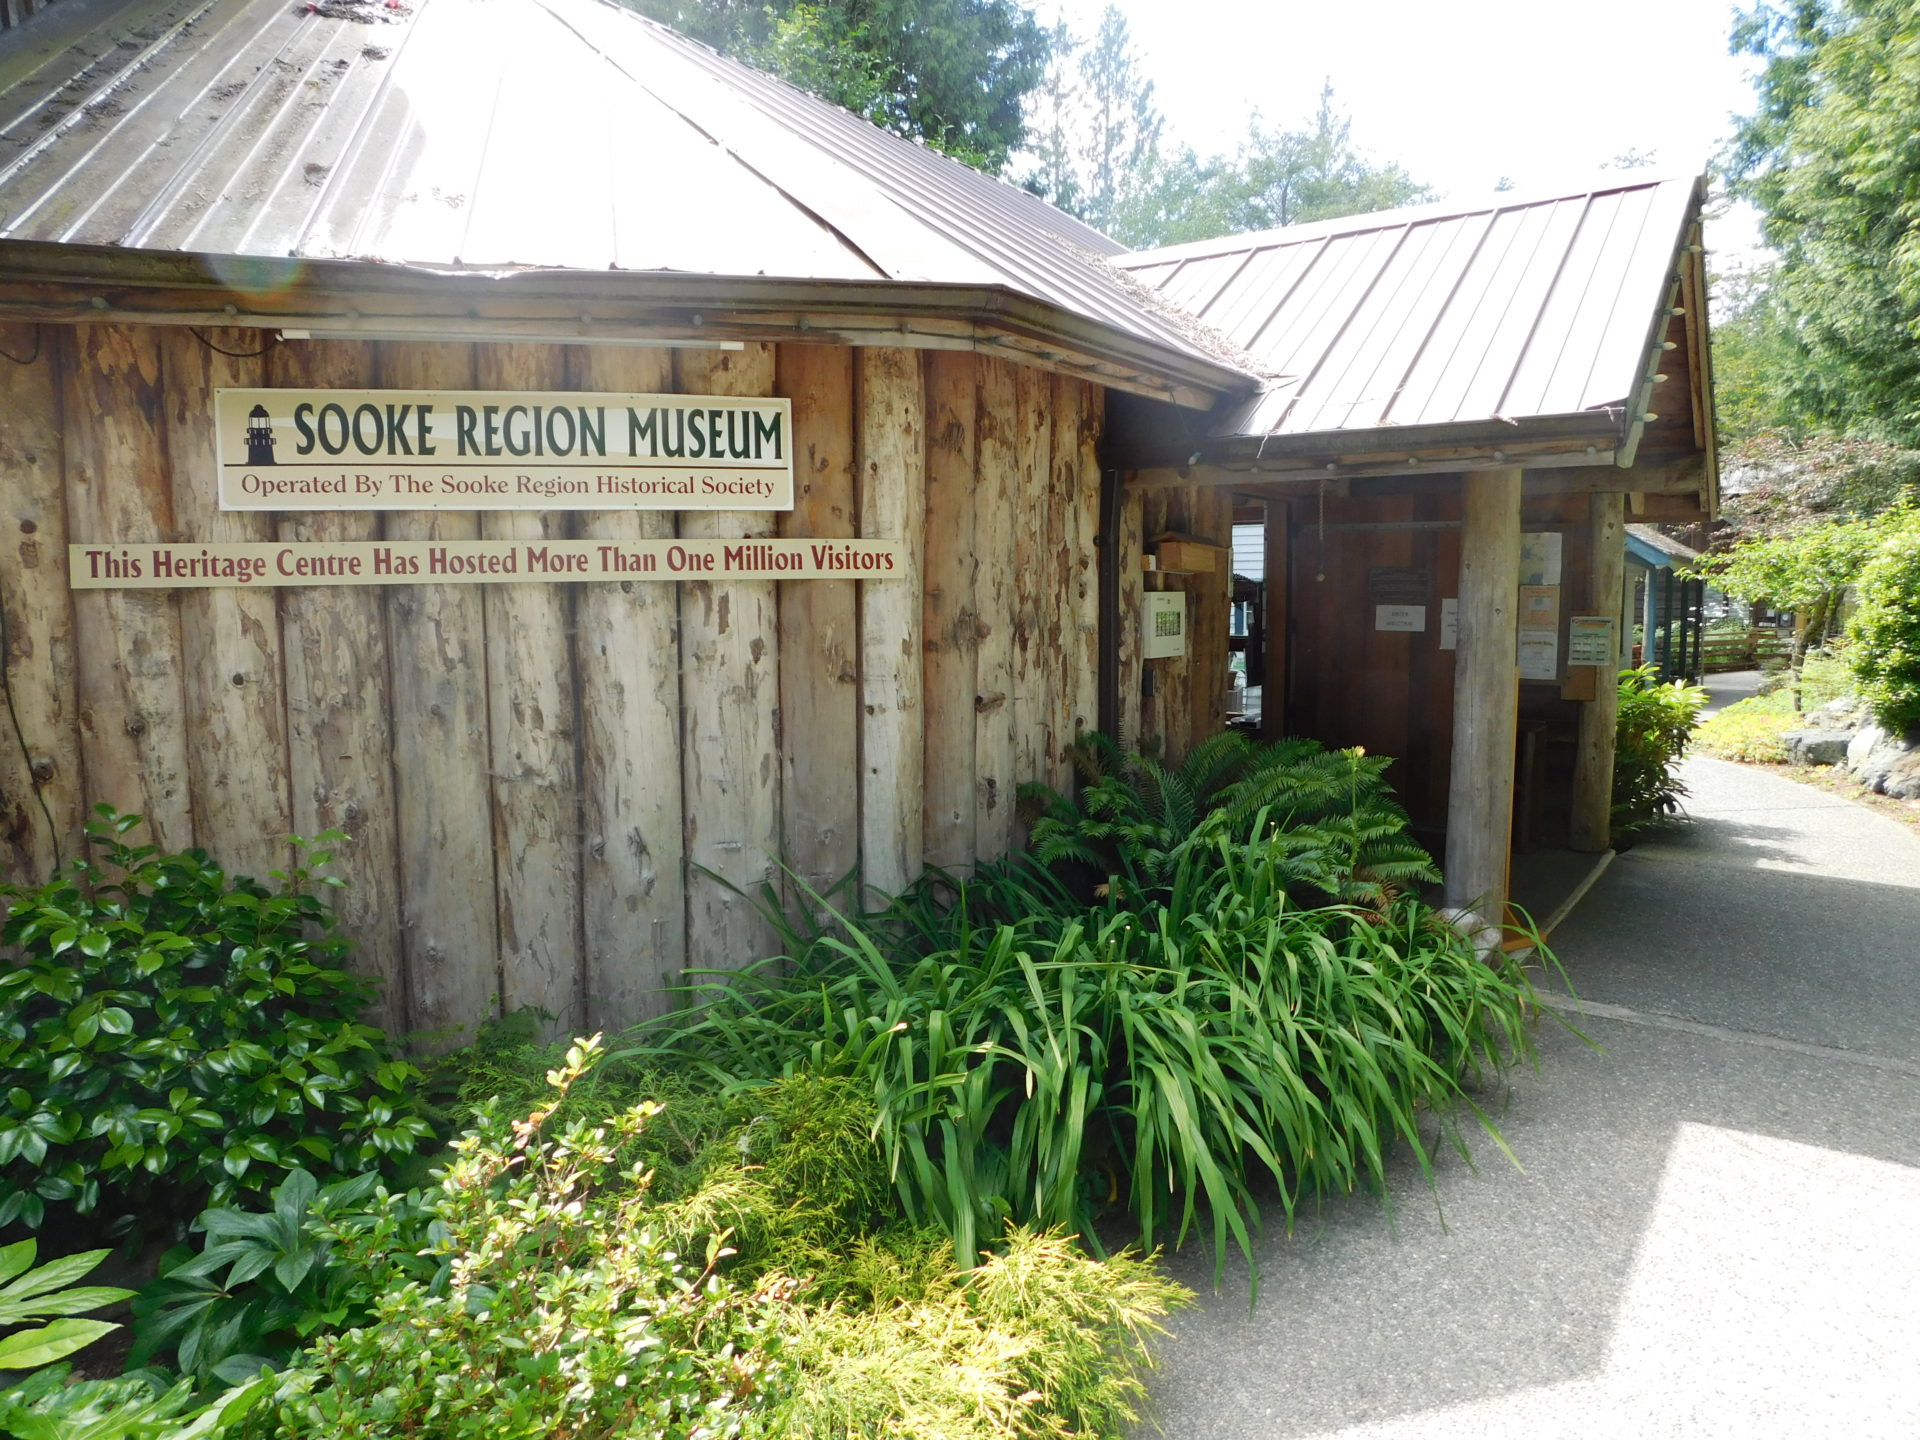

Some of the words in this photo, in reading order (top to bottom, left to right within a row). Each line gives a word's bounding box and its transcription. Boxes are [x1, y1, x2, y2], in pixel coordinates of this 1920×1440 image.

[294, 403, 437, 456] SOOKE
[455, 405, 607, 457] REGION
[626, 407, 783, 460] MUSEUM
[241, 474, 347, 497] Operated
[354, 475, 382, 497] By
[389, 475, 434, 493] The
[441, 475, 509, 494] Sooke
[516, 476, 589, 498] Region
[596, 476, 695, 495] Historical
[702, 476, 774, 498] Society
[85, 550, 142, 579] This
[152, 549, 266, 583] Heritage
[276, 549, 362, 577] Centre
[373, 547, 420, 575] Has
[429, 547, 517, 575] Hosted
[526, 546, 589, 573] More
[597, 546, 656, 573] Than
[666, 546, 715, 572] One
[724, 545, 803, 571] Million
[811, 544, 894, 571] Visitors
